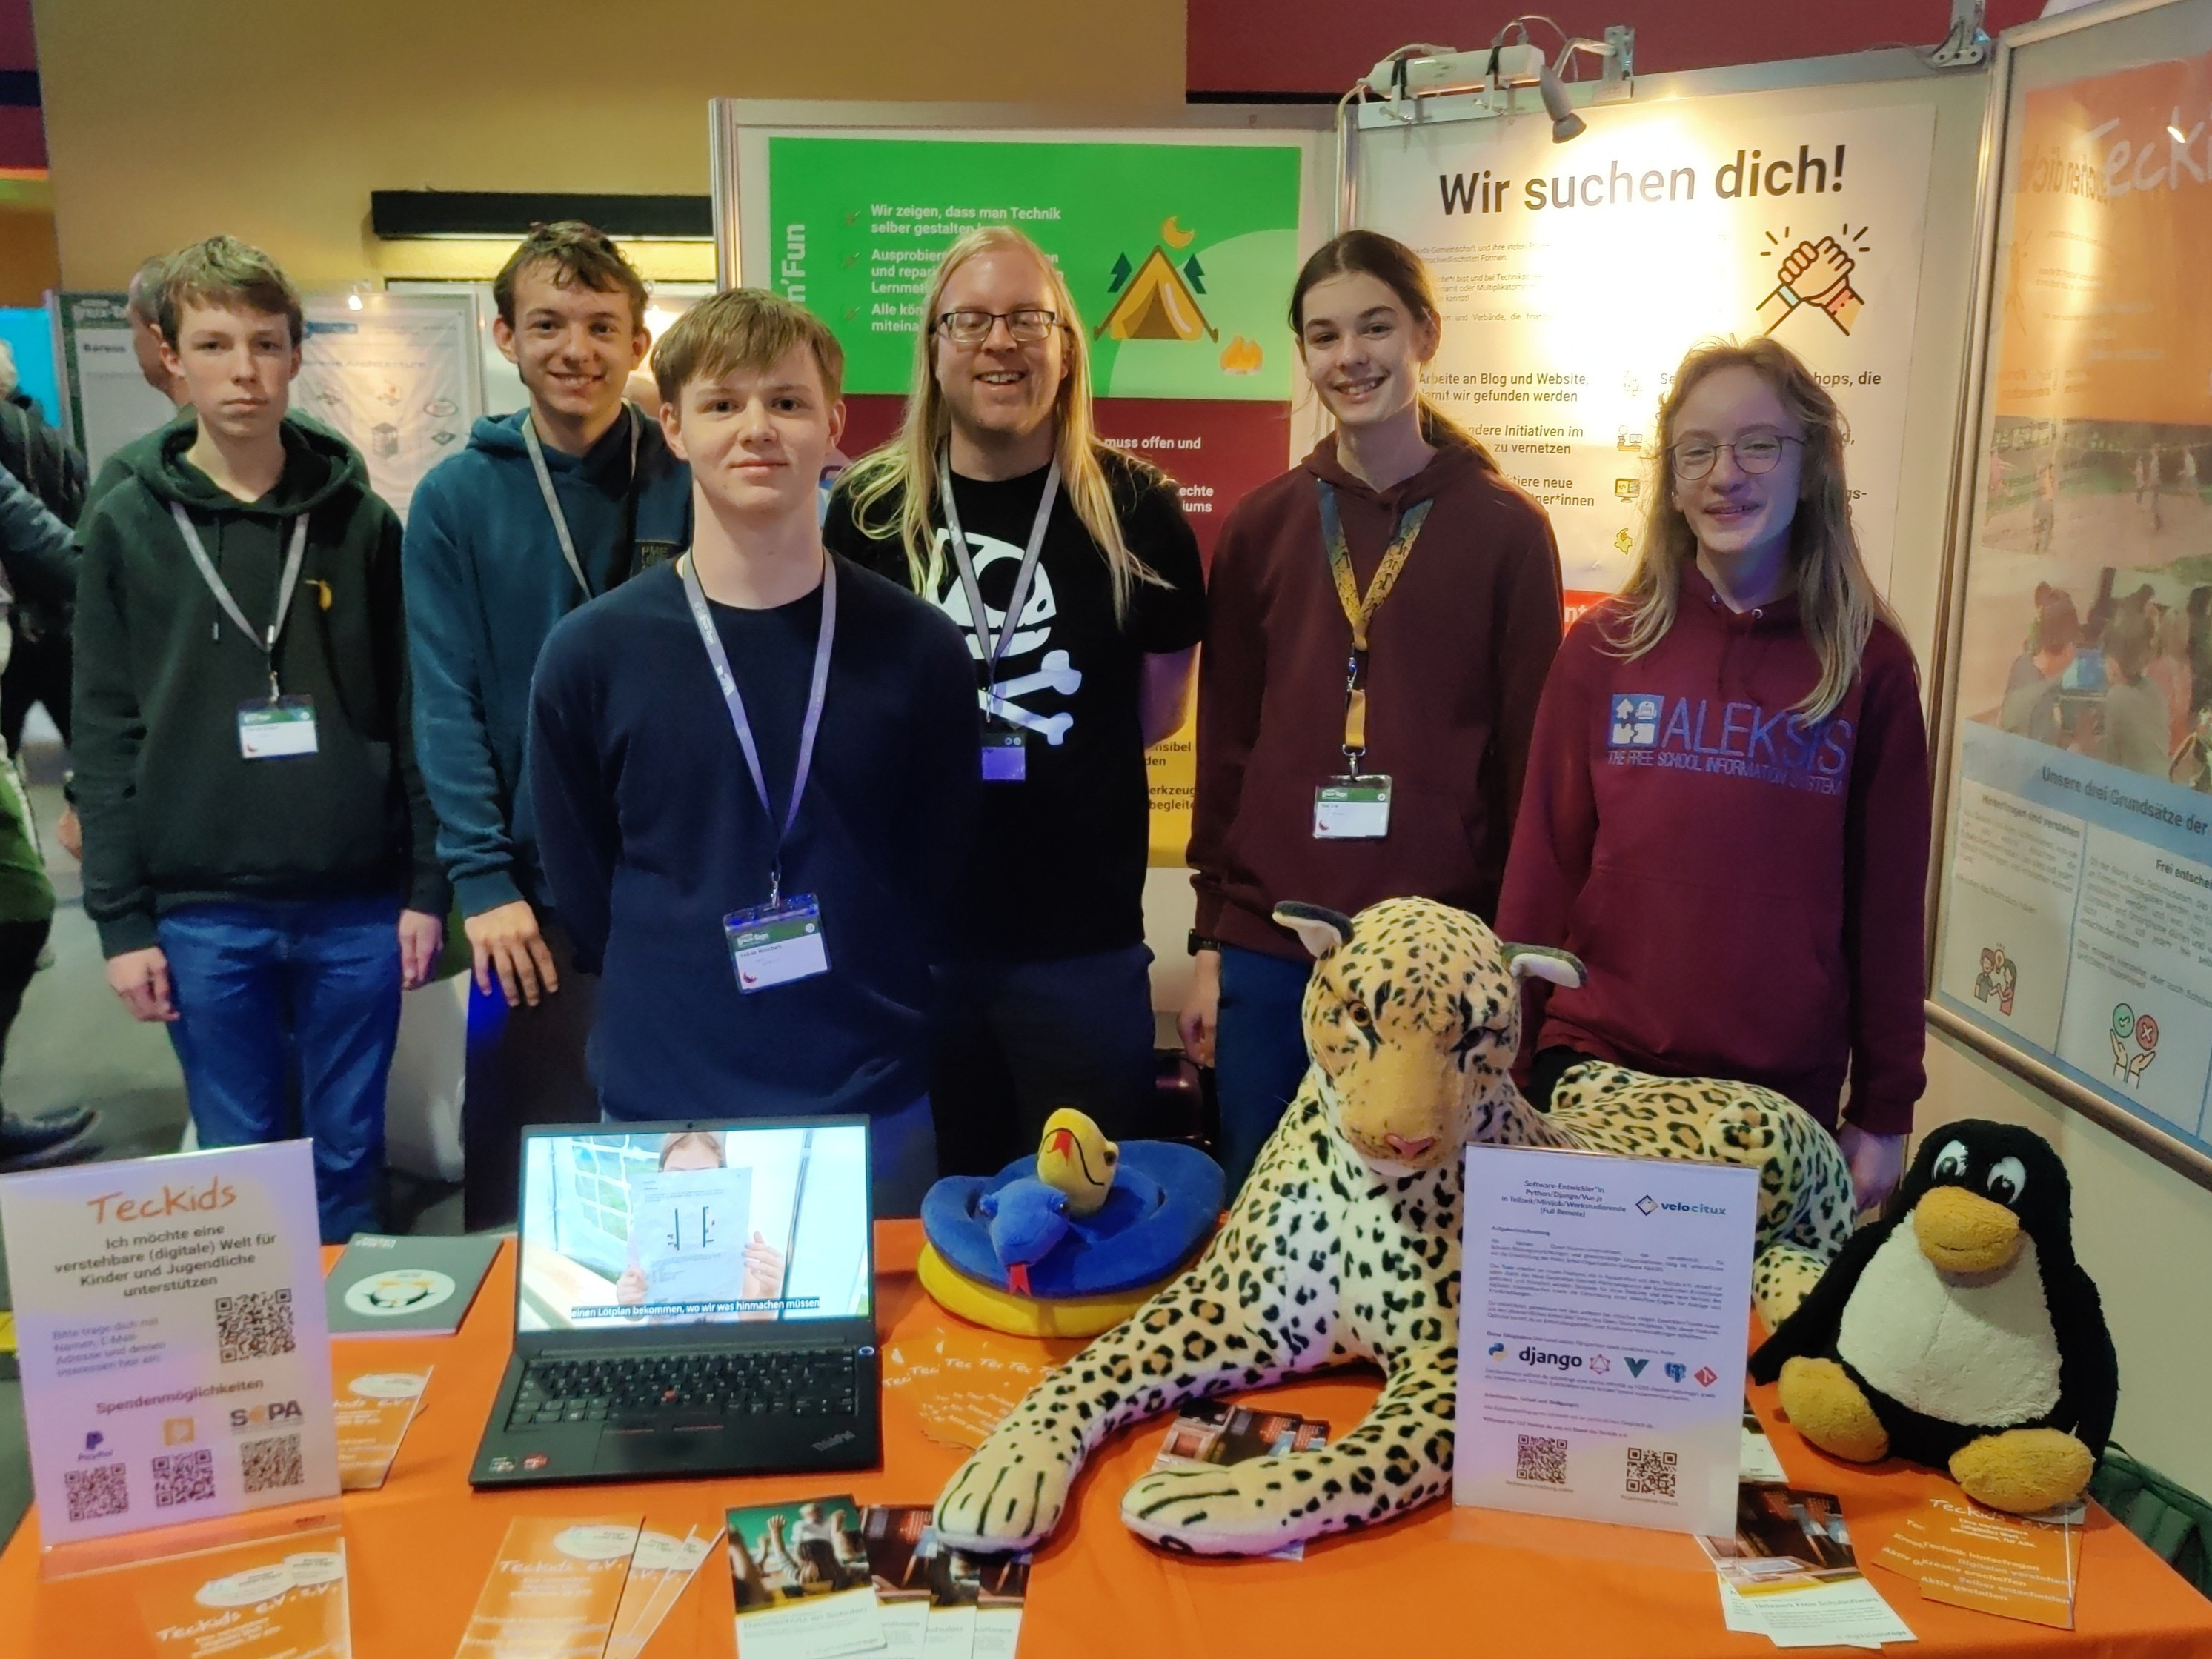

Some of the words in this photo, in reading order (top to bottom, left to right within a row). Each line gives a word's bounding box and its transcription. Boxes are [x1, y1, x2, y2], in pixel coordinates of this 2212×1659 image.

[1440, 170, 1510, 215] Wir
[1525, 159, 1695, 210] suchen
[1715, 144, 1847, 199] dich!
[871, 205, 892, 217] Wir
[896, 206, 942, 219] zeigen,
[946, 205, 976, 218] dass
[979, 208, 1007, 219] man
[1010, 207, 1061, 220] Technik
[871, 221, 911, 233] selber
[914, 223, 974, 236] gestalten
[871, 265, 895, 277] und
[871, 304, 896, 316] Alle
[1455, 313, 1468, 322] und
[1419, 373, 1459, 385] Arbeite
[1463, 375, 1477, 385] an
[1481, 373, 1507, 388] Blog
[1510, 373, 1532, 385] und
[1536, 373, 1589, 387] Website,
[1858, 371, 1881, 385] die
[1452, 390, 1471, 401] wir
[1473, 390, 1530, 403] gefunden
[1533, 390, 1578, 402] werden
[1505, 425, 1564, 437] Initiativen
[1568, 425, 1584, 437] im
[1142, 436, 1174, 448] offen
[1178, 436, 1201, 449] und
[1494, 443, 1508, 453] zu
[1511, 443, 1571, 454] vernetzen
[1544, 478, 1572, 489] neue
[1607, 750, 1626, 765] THE
[1627, 750, 1653, 767] FREE
[1658, 752, 1702, 771] SCHOOL
[2042, 765, 2082, 794] Unsere
[2085, 779, 2108, 802] drei
[2111, 788, 2183, 827] Grundsätze
[2186, 814, 2208, 836] der
[2156, 859, 2173, 876] Frei
[87, 1174, 237, 1224] Teckids
[1661, 1202, 1727, 1215] velocitux
[105, 1236, 129, 1249] Ich
[133, 1229, 190, 1246] möchte
[193, 1225, 225, 1237] eine
[54, 1251, 145, 1273] verstehbare
[148, 1244, 216, 1262] (digitale)
[219, 1237, 253, 1251] Welt
[256, 1233, 277, 1246] für
[80, 1271, 129, 1287] Kinder
[133, 1265, 162, 1279] und
[166, 1253, 256, 1276] Jugendliche
[123, 1277, 219, 1297] unterstützen
[572, 1309, 596, 1317] einen
[632, 1304, 685, 1315] bekommen,
[686, 1305, 700, 1313] wo
[702, 1303, 717, 1311] wir
[718, 1303, 734, 1311] was
[736, 1300, 785, 1311] hinmachen
[786, 1298, 820, 1309] müssen
[1518, 1346, 1583, 1371] django
[96, 1378, 264, 1414] Spendenmöglichkeiten
[230, 1400, 303, 1427] SPA
[1968, 1551, 2040, 1572] hinterfragen
[1920, 1575, 1950, 1588] Aktiv
[1953, 1583, 2009, 1601] gestalten
